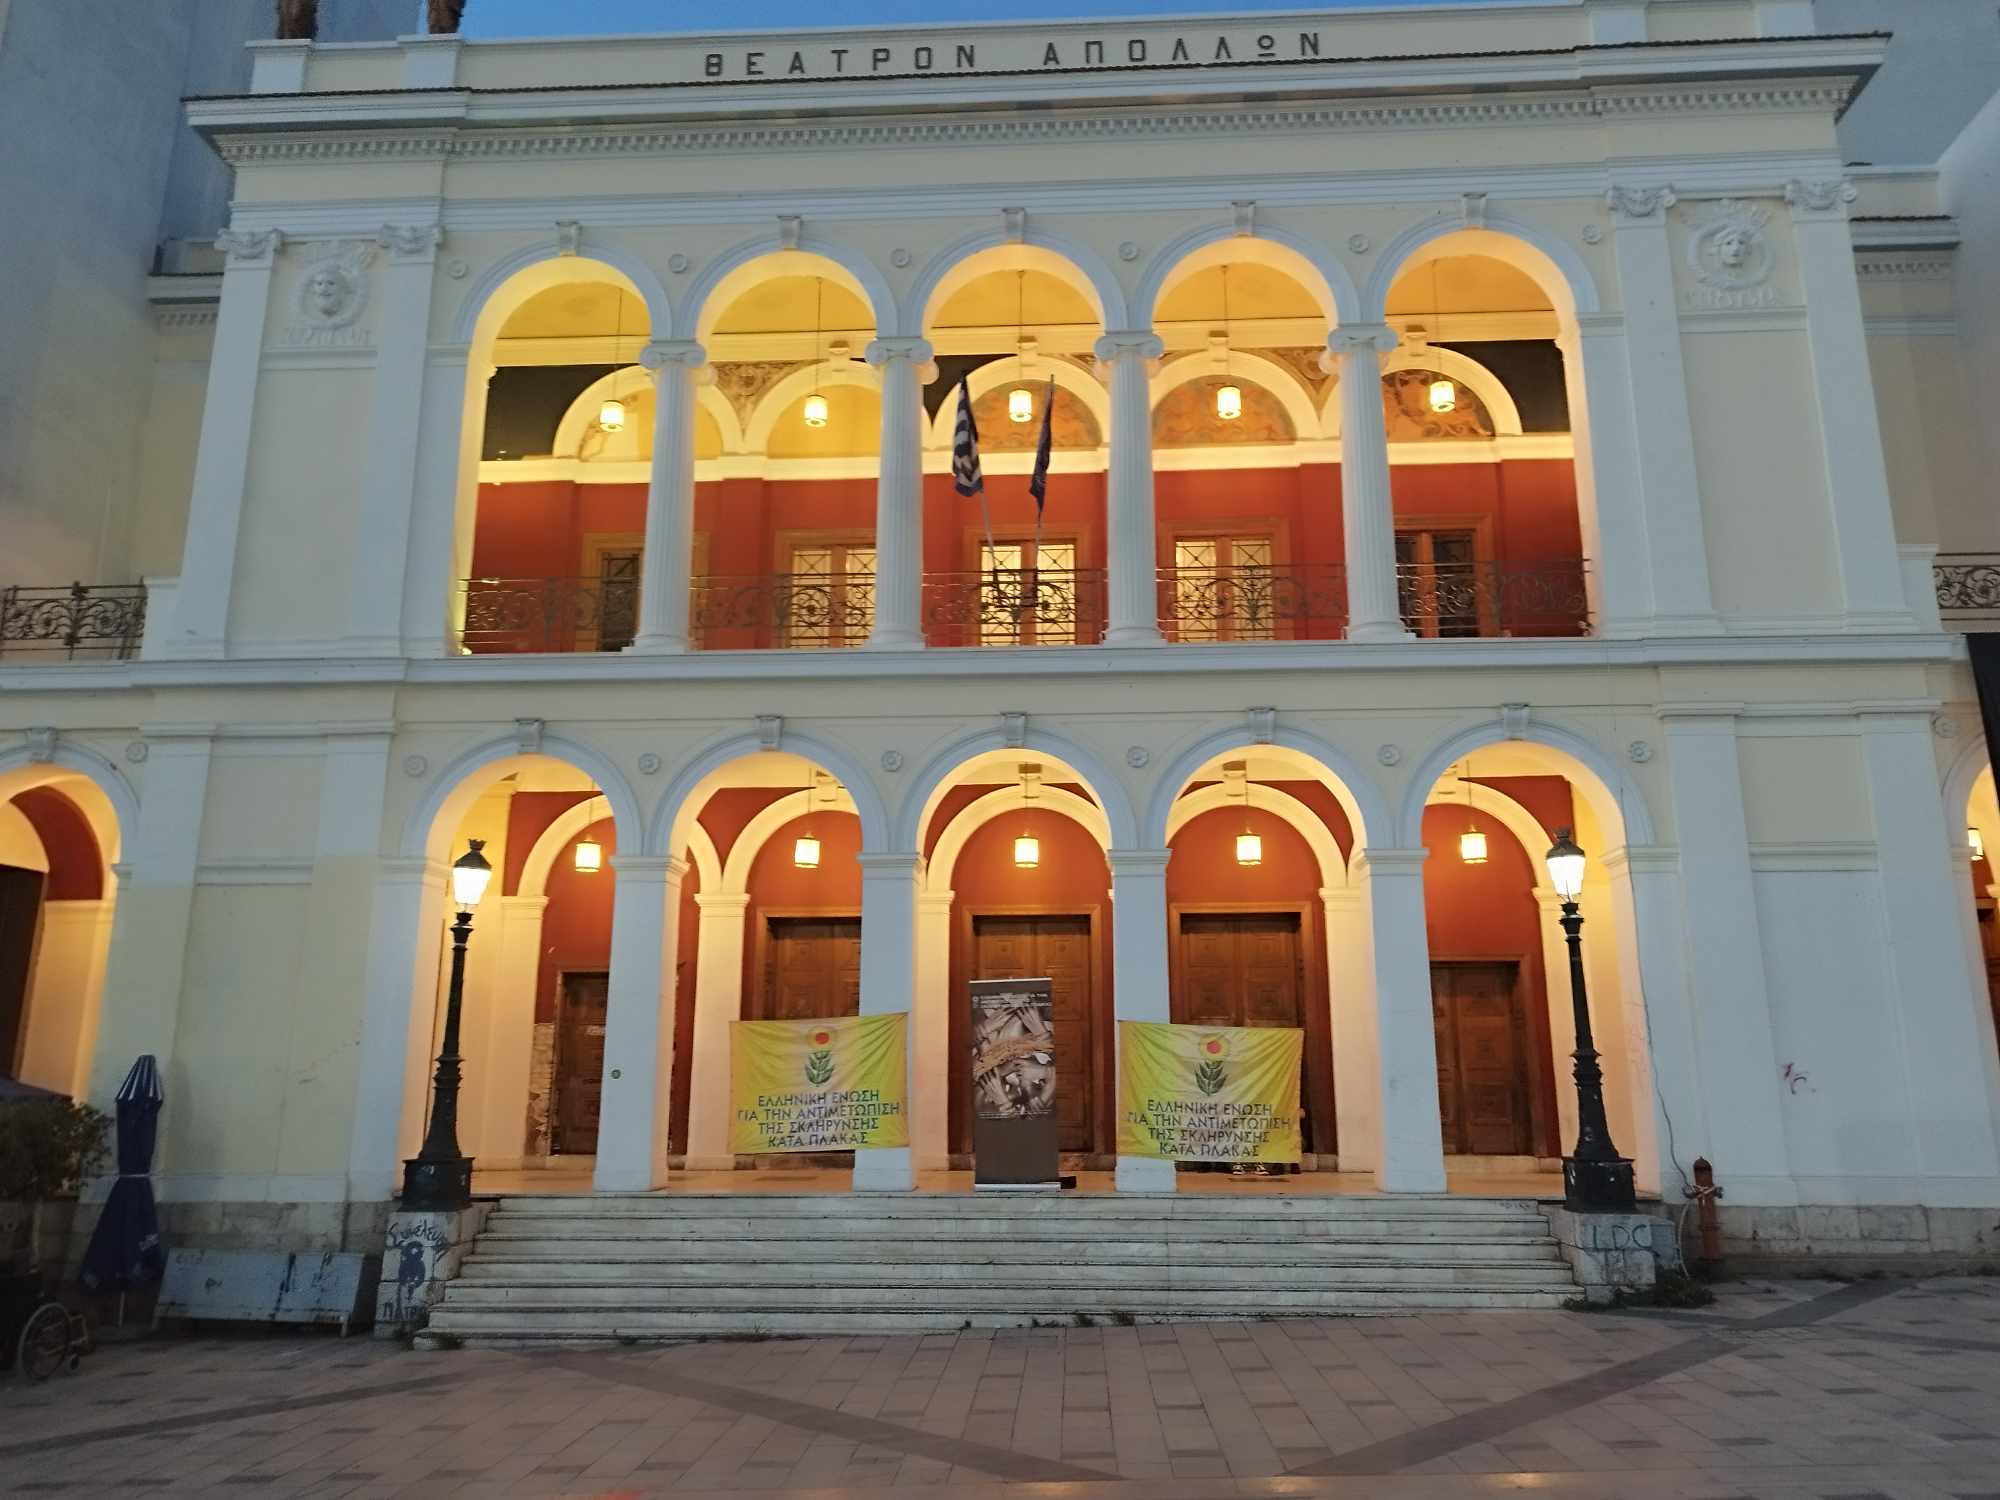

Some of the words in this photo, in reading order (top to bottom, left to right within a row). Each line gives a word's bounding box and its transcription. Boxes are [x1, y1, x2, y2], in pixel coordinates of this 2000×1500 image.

[1043, 32, 1319, 67] ΑΠΟΛΛΩΝ
[758, 1092, 826, 1107] ΕΛΛΗΝΙΚΗ
[833, 1089, 879, 1104] ΕΝΩΣΗ
[737, 1109, 759, 1121] ΓΙΑ
[765, 1108, 791, 1121] ΤΗΝ
[798, 1102, 900, 1120] ΑΝΤΙΜΕΤΩΠΙΣΗ
[1147, 1099, 1218, 1115] ΕΛΛΗΝΙΚΗ
[1224, 1103, 1273, 1116] ΕΝΩΣΗ
[759, 1121, 784, 1134] ΤΗΣ
[790, 1117, 880, 1133] ΣΚΛΗΡΥΝΣΗΣ
[1127, 1111, 1149, 1126] ΓΙΑ
[1153, 1113, 1182, 1127] ΤΗΝ
[1186, 1116, 1291, 1130] ΑΝΤΙΜΕΤΩΠΙΣΗ
[768, 1135, 805, 1148] ΚΑΤΑ
[809, 1131, 869, 1146] ΠΛΑΚΑΣ
[1148, 1127, 1175, 1141] ΤΗΣ
[1180, 1129, 1271, 1143] ΣΚΛΗΡΥΝΣΗΣ
[1159, 1142, 1196, 1155] ΚΑΤΑ
[1200, 1143, 1260, 1157] ΠΛΑΚΑΣ
